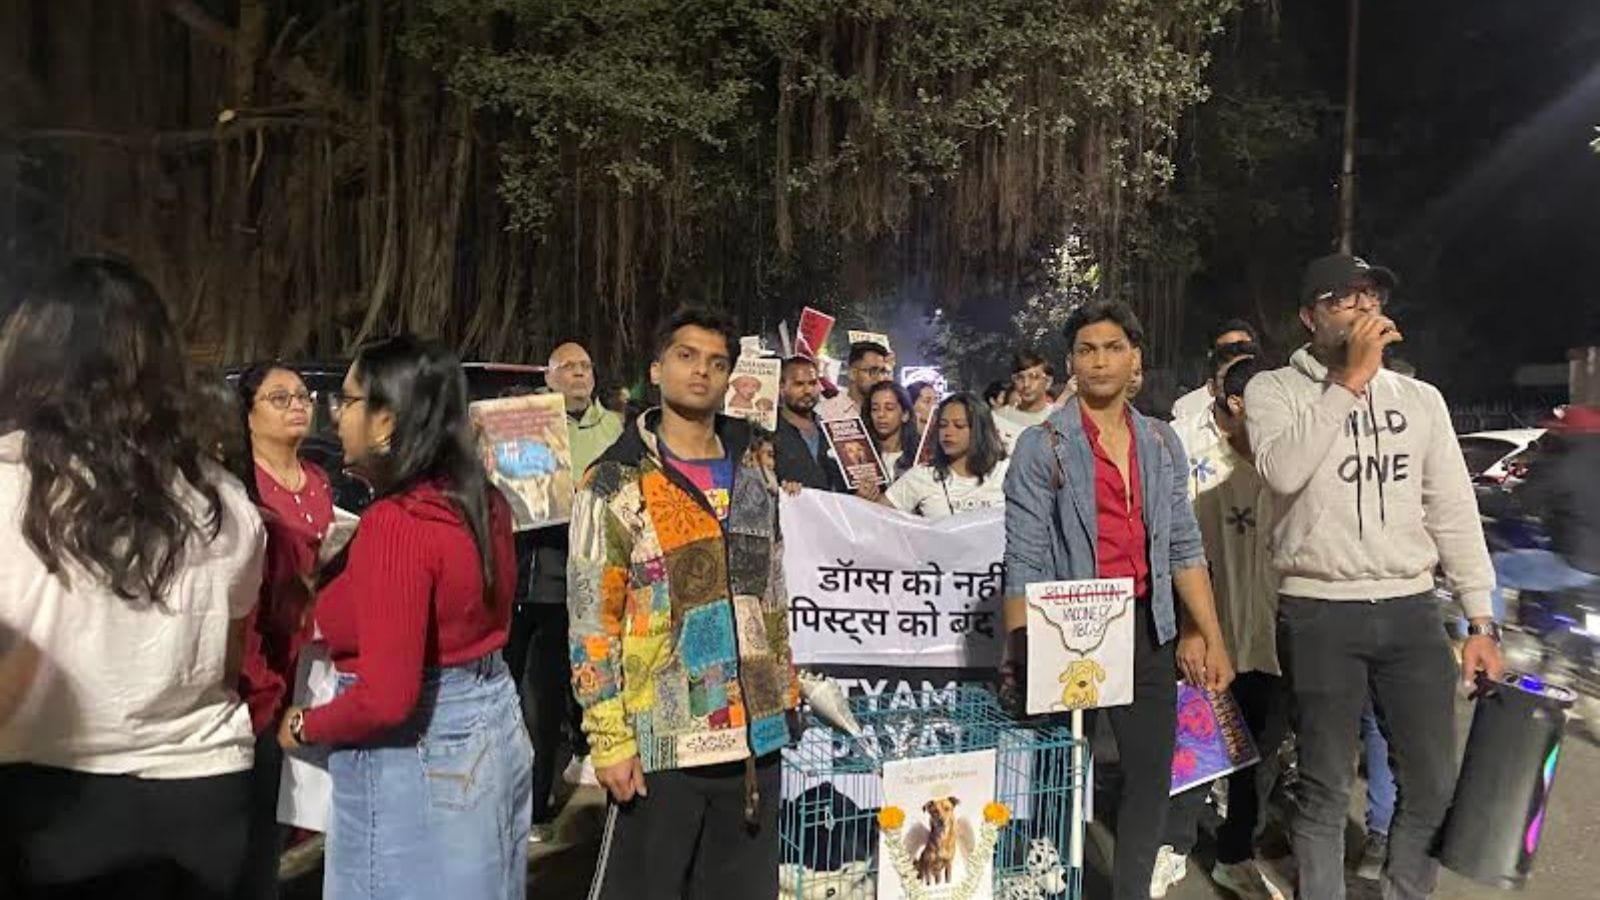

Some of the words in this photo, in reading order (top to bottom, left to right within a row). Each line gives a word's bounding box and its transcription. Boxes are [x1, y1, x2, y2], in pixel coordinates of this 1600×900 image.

[1338, 454, 1410, 483] ONE
[818, 558, 893, 595] डॉग्स
[901, 562, 944, 596] को
[788, 596, 890, 645] पिस्ट्स
[897, 600, 940, 638] को
[949, 603, 995, 639] बंद
[796, 677, 958, 712] TYAM
